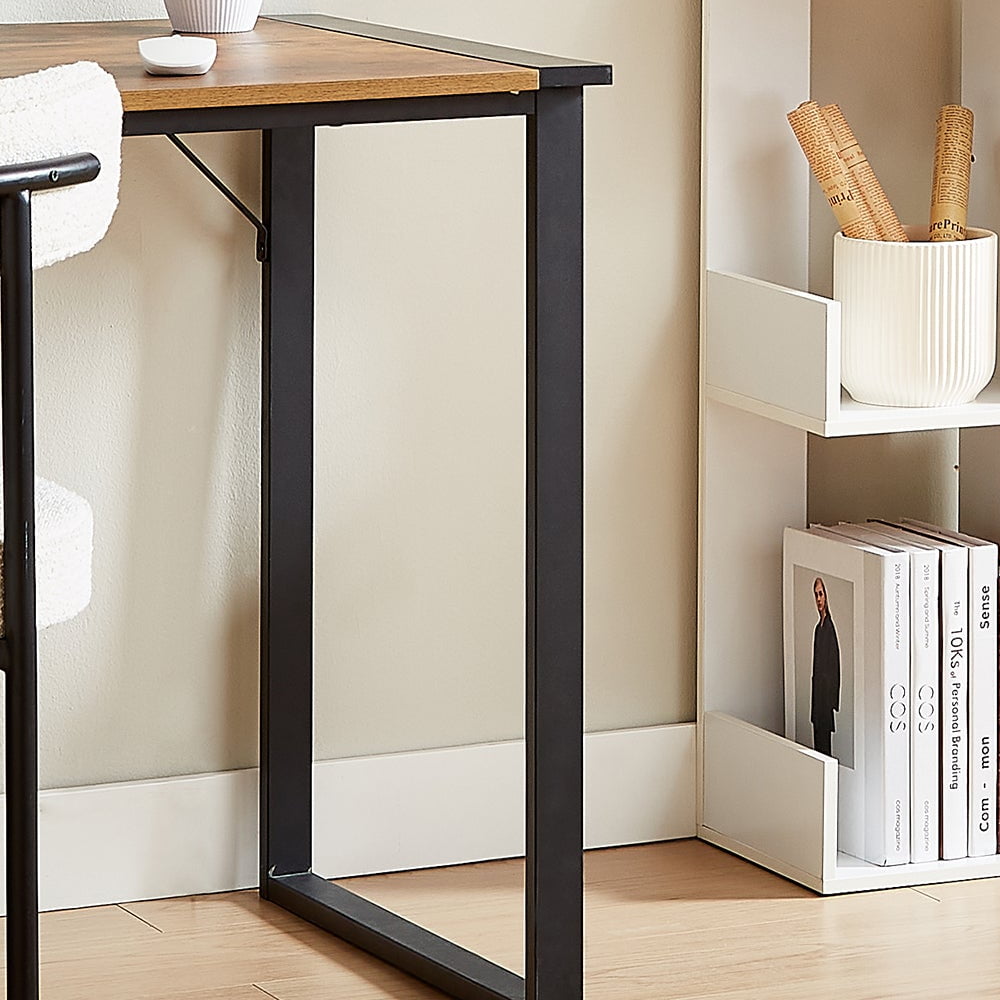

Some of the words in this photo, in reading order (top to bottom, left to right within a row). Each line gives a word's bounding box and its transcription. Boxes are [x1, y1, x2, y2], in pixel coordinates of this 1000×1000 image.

[929, 218, 967, 235] rePrin
[894, 563, 902, 580] 2018
[979, 585, 990, 629] Sense
[950, 627, 964, 669] 10Ks
[950, 671, 957, 679] of
[890, 683, 906, 733] COS
[918, 684, 934, 733] COS
[951, 682, 961, 733] Personal
[949, 735, 961, 790] Branding
[981, 736, 990, 769] mon
[979, 797, 989, 832] Com
